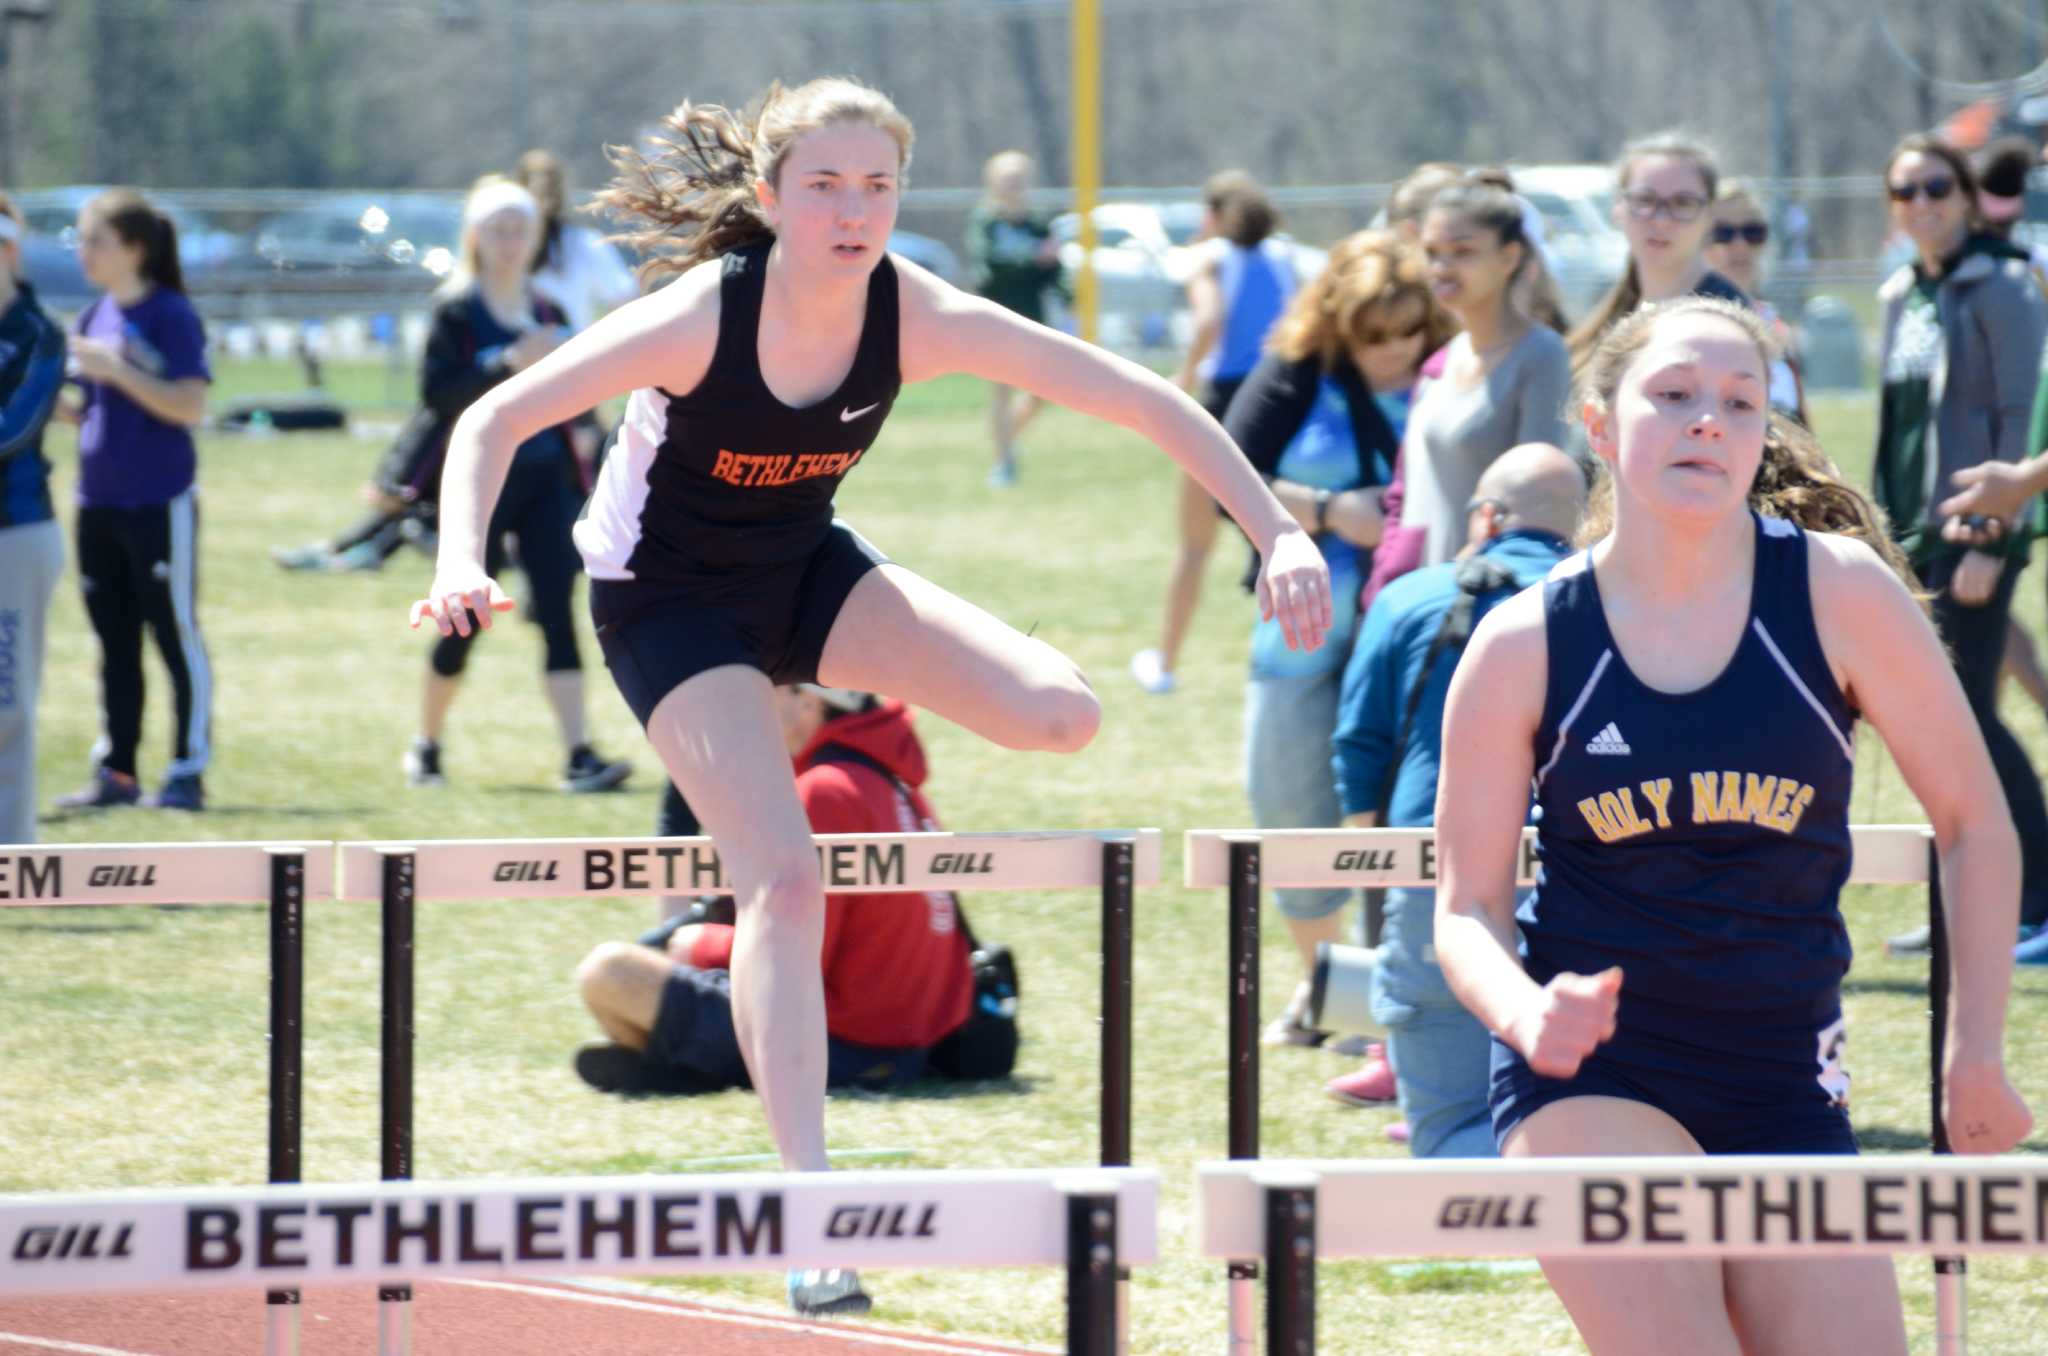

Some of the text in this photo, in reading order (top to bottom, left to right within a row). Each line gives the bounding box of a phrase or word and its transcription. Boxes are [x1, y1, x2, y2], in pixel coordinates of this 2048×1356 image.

[1577, 771, 1816, 843] HOLY NAMES
[88, 865, 157, 886] GILL
[494, 844, 994, 891] GILL BETHEM GILL
[1333, 850, 1396, 870] GILL
[12, 1194, 937, 1269] GILL BETHLEHEM GILL
[1437, 1177, 2048, 1244] GILL BETHLEHE
